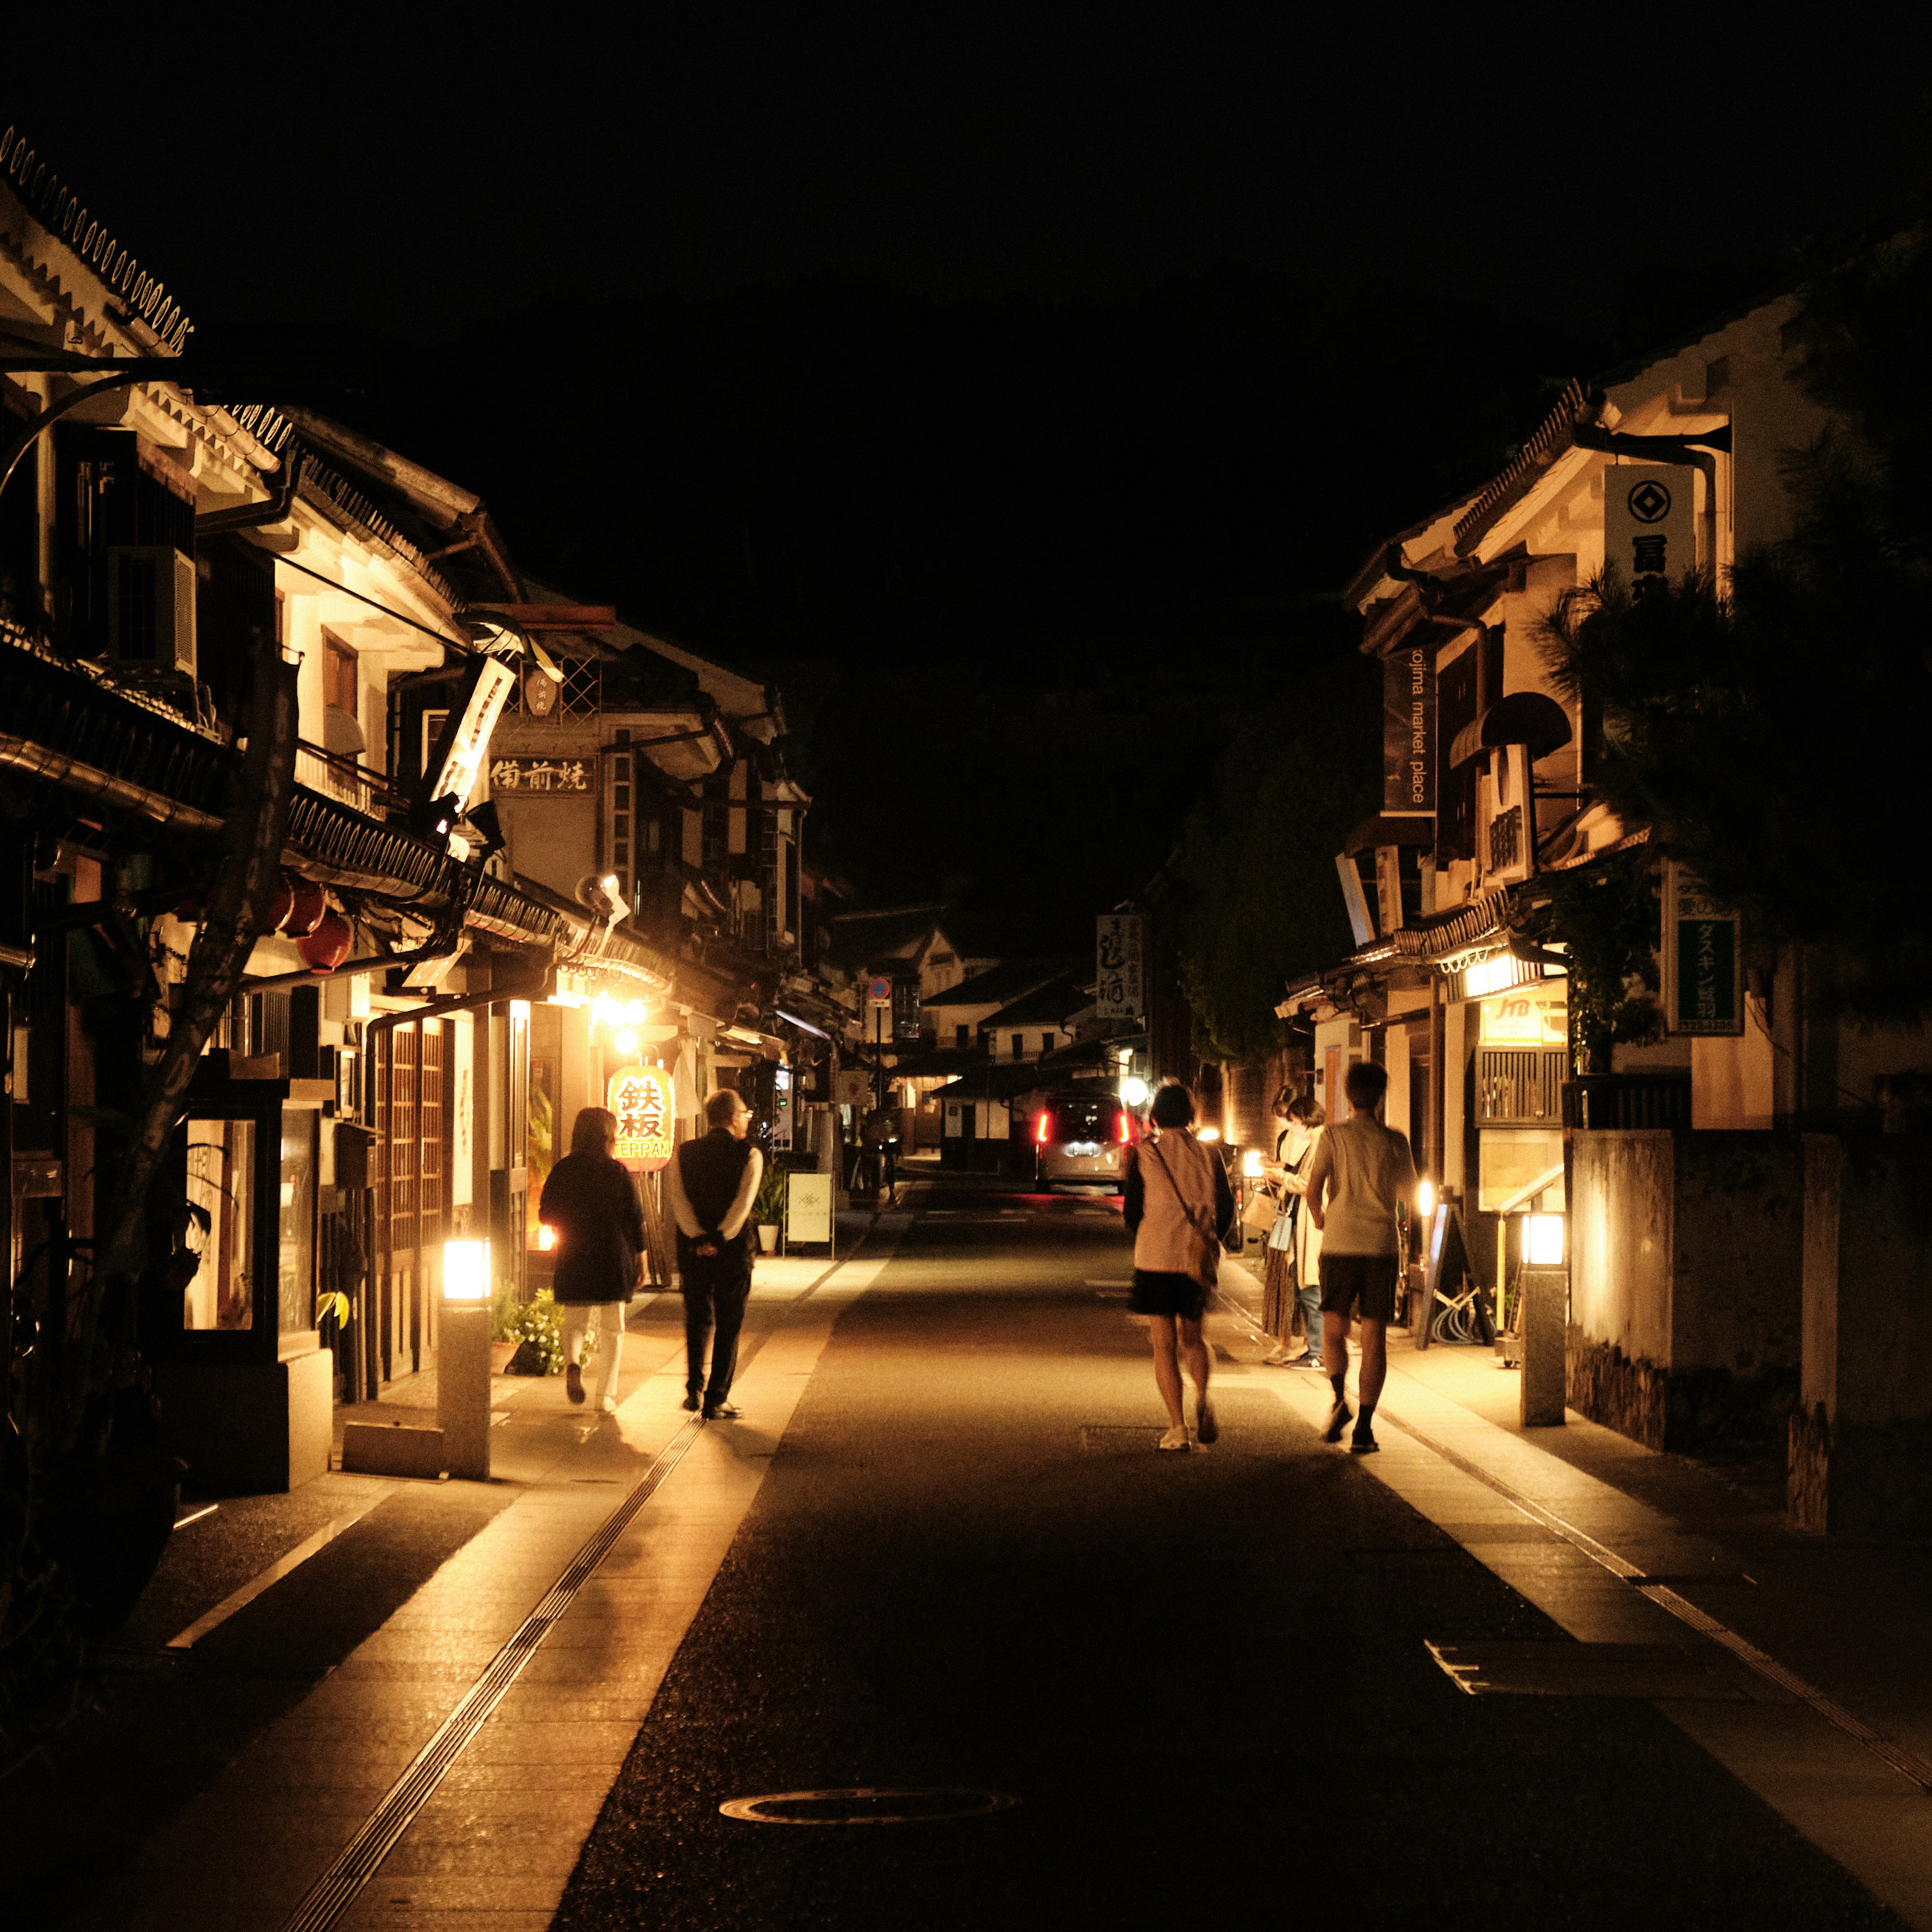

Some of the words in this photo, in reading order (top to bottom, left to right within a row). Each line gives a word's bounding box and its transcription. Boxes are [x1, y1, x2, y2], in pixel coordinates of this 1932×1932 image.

[1412, 702, 1427, 755] market
[490, 760, 587, 791] 備前焼
[1410, 761, 1427, 804] place
[1495, 999, 1530, 1020] JTB
[618, 1081, 663, 1137] 鉄板
